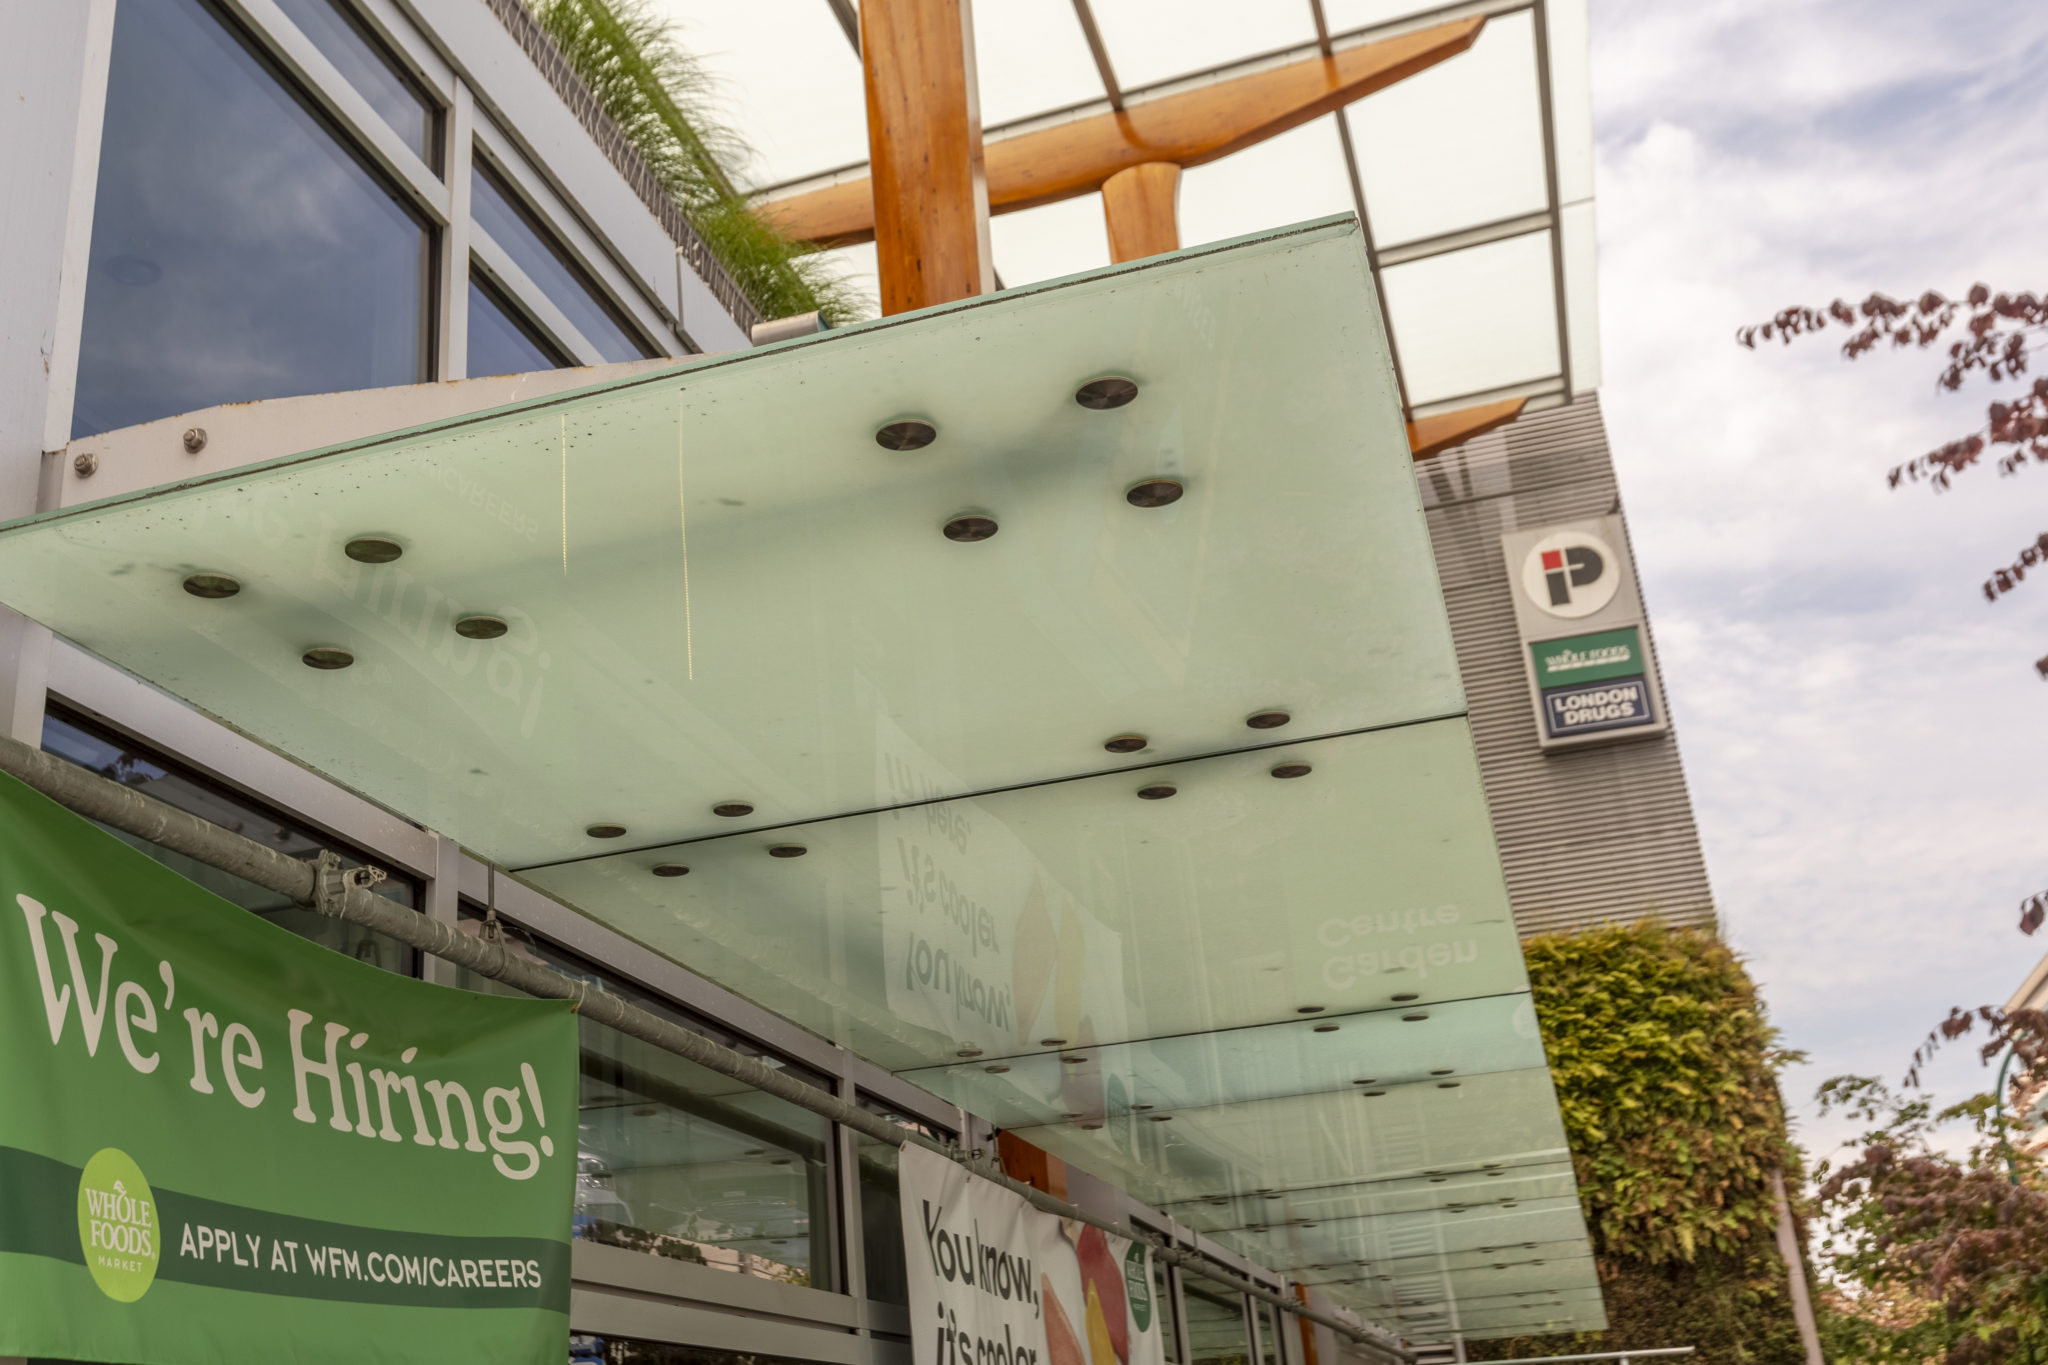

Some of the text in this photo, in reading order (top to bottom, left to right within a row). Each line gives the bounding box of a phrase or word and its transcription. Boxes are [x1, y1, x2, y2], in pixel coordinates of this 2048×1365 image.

[1554, 685, 1639, 713] LONDON
[1563, 701, 1636, 726] DRUGS
[16, 893, 555, 1181] We're Hiring!
[84, 1183, 152, 1228] WHOLE
[90, 1219, 152, 1258] FOODS
[180, 1222, 541, 1288] APPLY AT WFM.COM/CAREERS
[923, 1199, 975, 1286] You
[974, 1218, 1040, 1320] know,
[98, 1255, 143, 1273] MARKET
